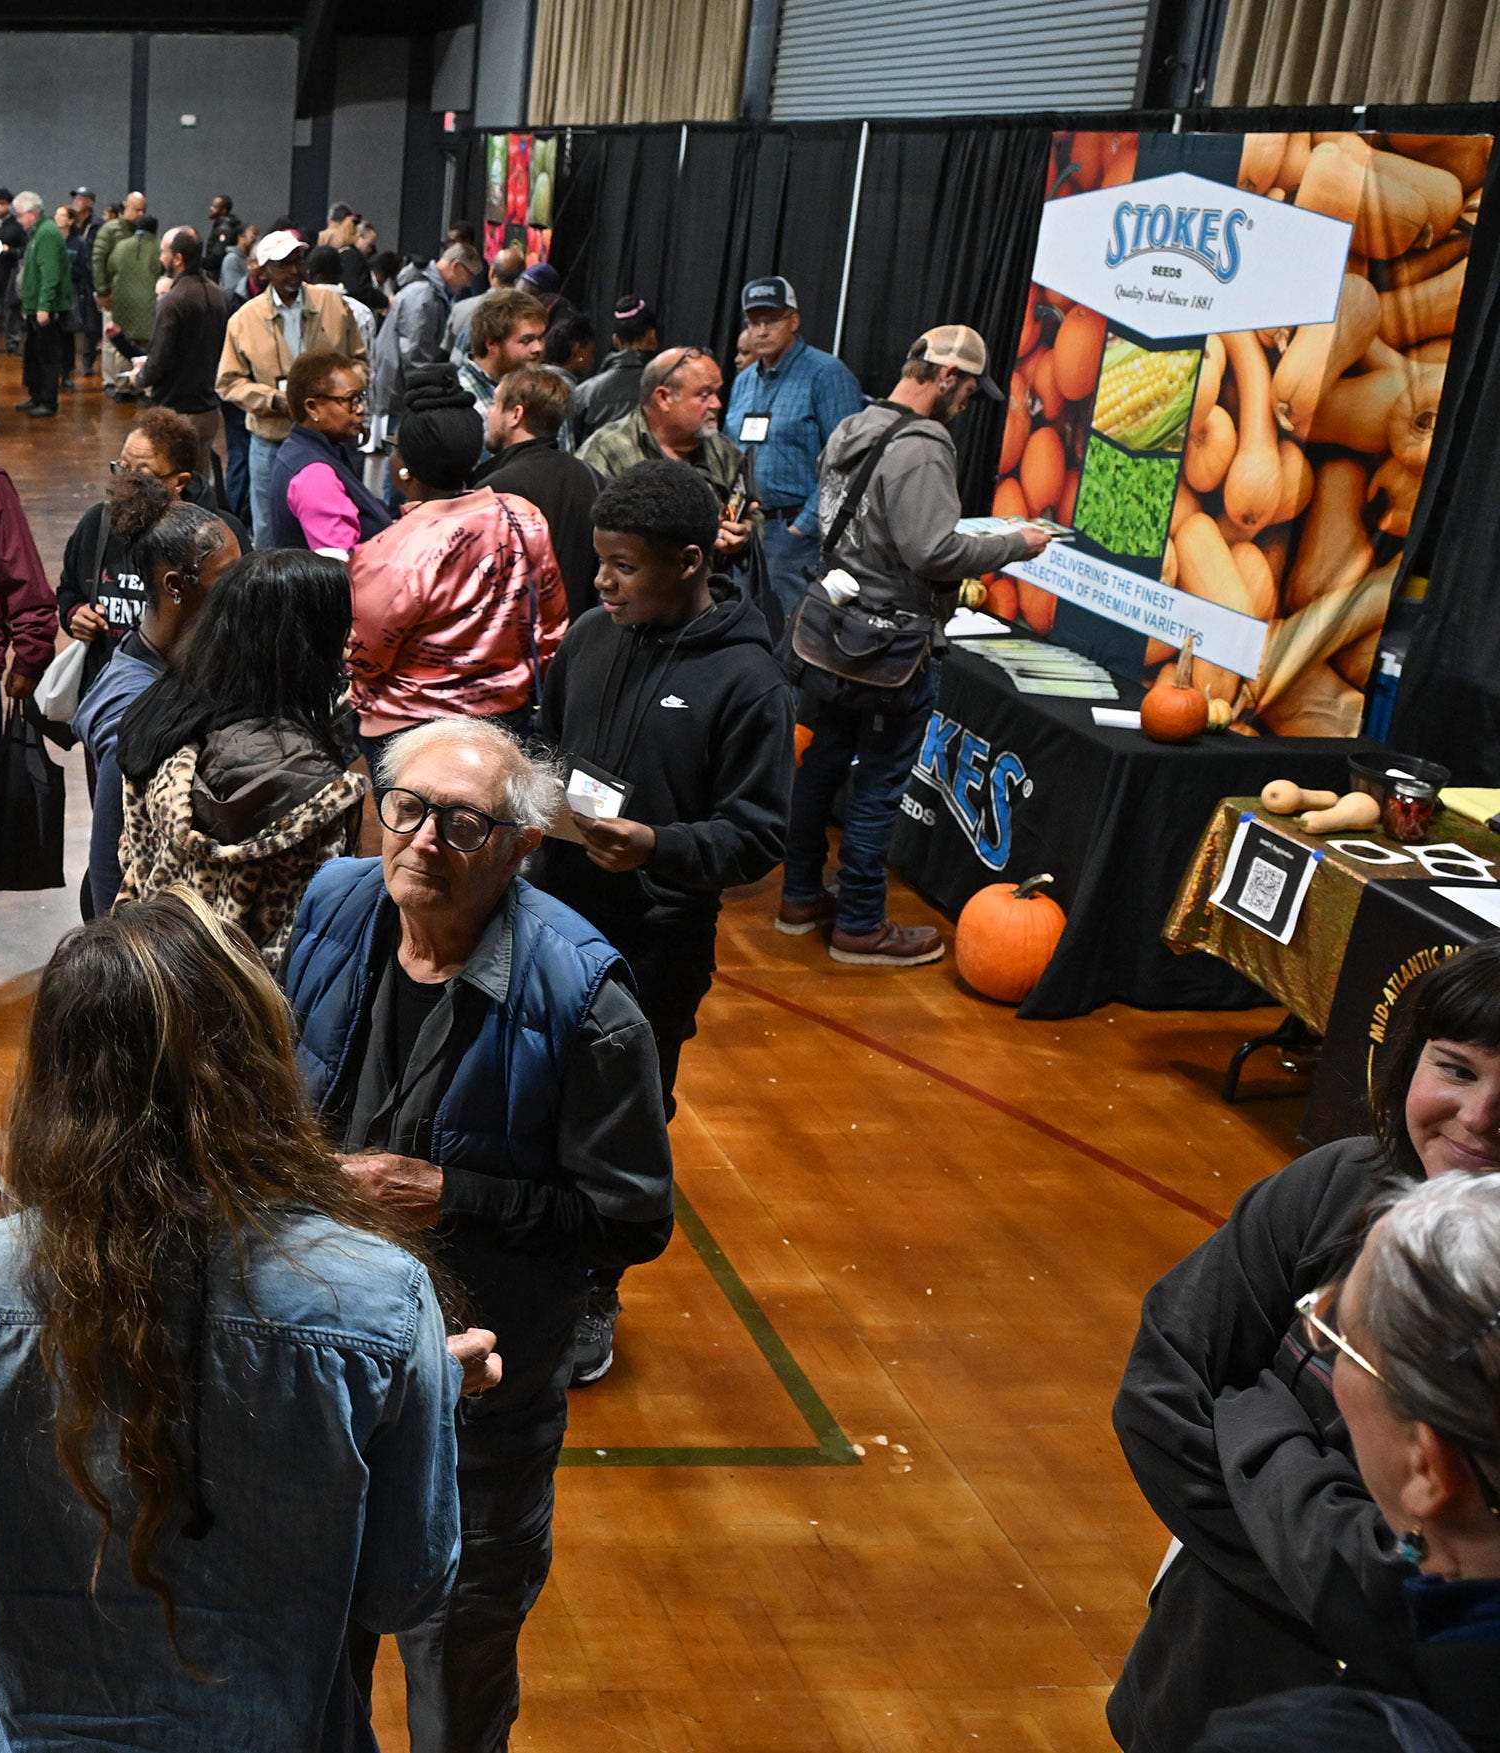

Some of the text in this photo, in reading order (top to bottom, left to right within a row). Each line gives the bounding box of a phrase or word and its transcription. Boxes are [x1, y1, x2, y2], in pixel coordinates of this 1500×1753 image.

[1106, 201, 1248, 284] STOKES
[1151, 264, 1183, 279] SEEDS
[1114, 283, 1214, 311] Quality Seed Since 1881
[1022, 561, 1074, 592] SELECTION
[1076, 582, 1090, 598] OF
[1092, 588, 1141, 619] PREMIUM
[1050, 550, 1176, 612] DELIVERING THE FINEST
[918, 709, 1027, 871] KES
[1369, 946, 1441, 1043] MID-ATLANTIC
